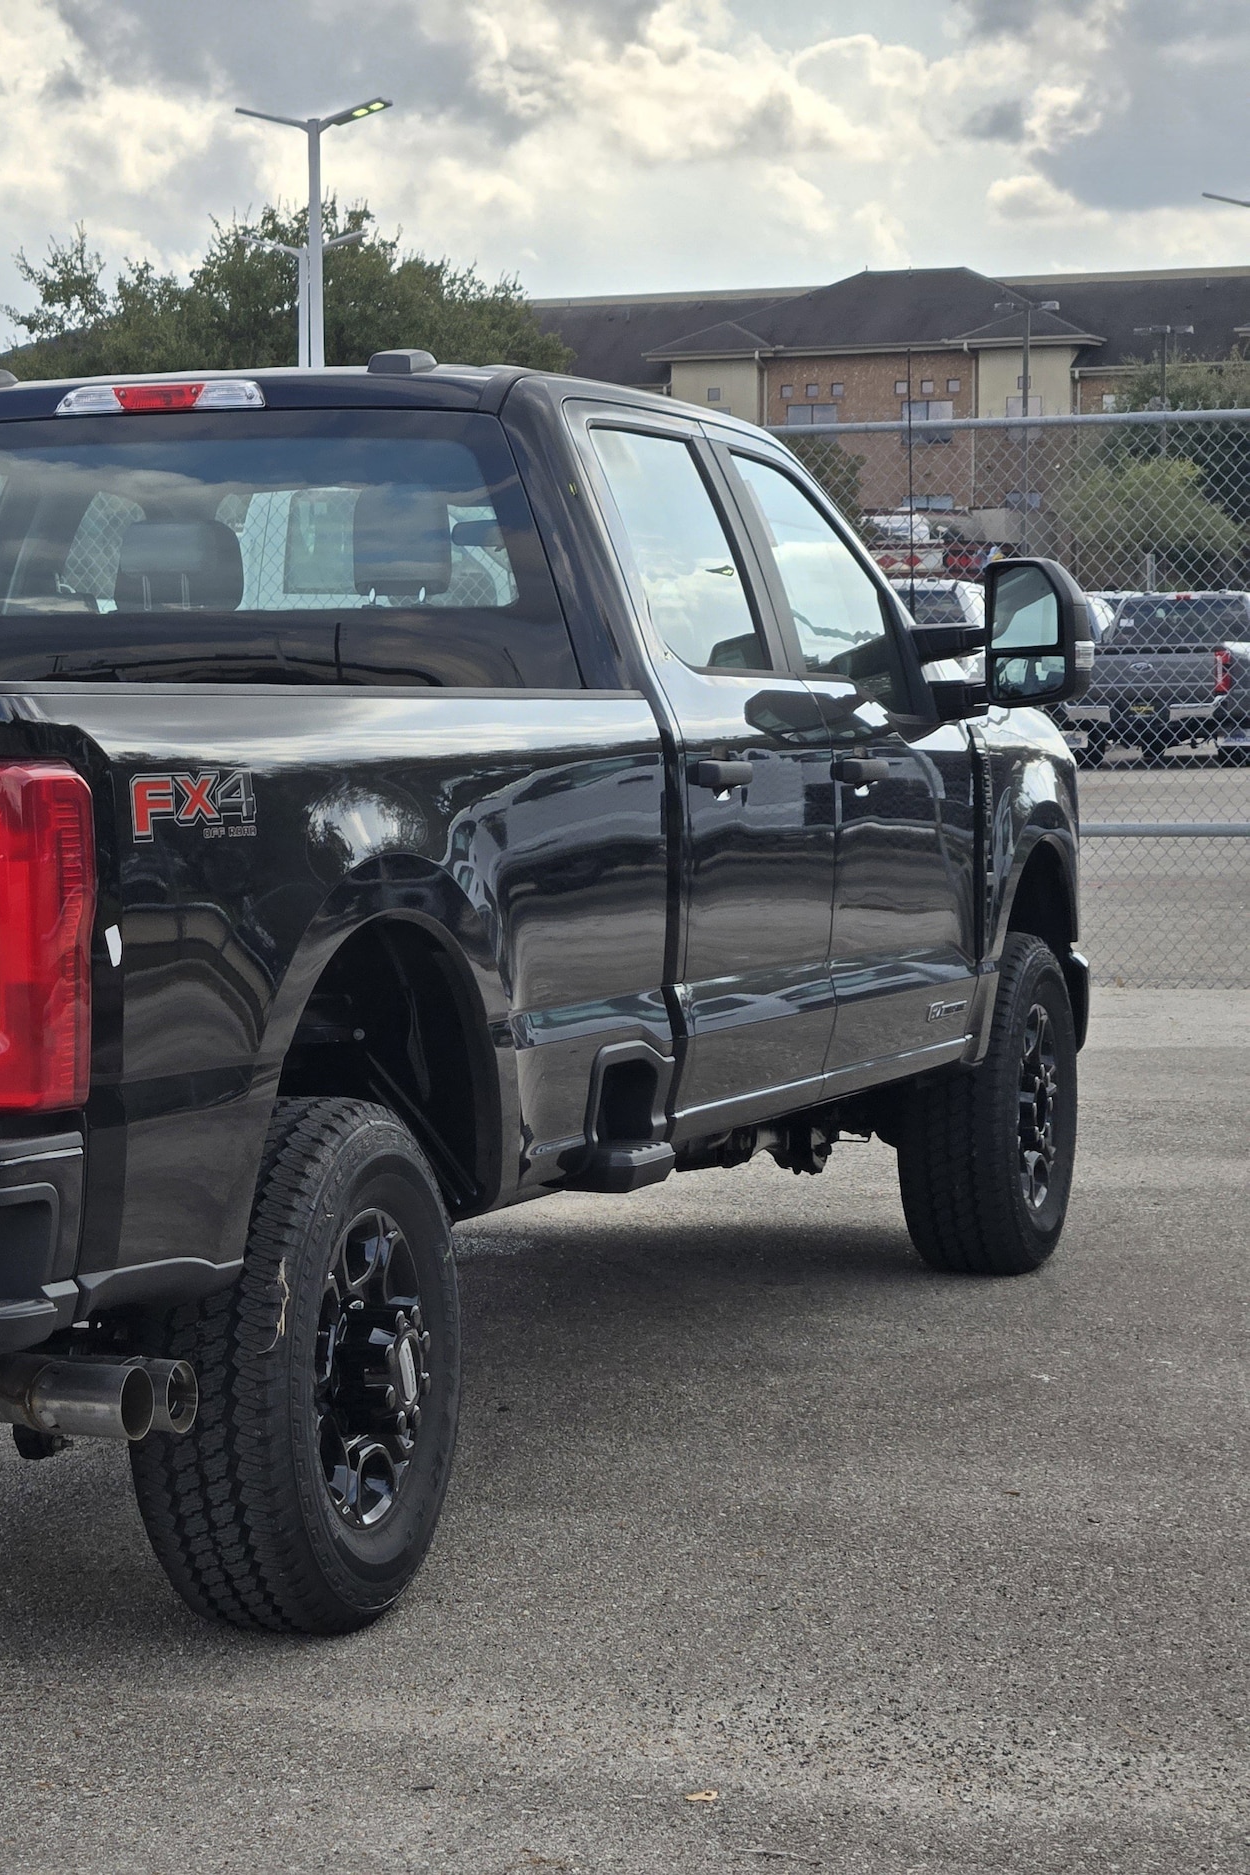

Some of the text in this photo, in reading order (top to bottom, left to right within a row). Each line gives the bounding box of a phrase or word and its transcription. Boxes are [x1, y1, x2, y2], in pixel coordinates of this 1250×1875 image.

[130, 769, 257, 844] FX4
[203, 825, 258, 839] OFF ROAD
